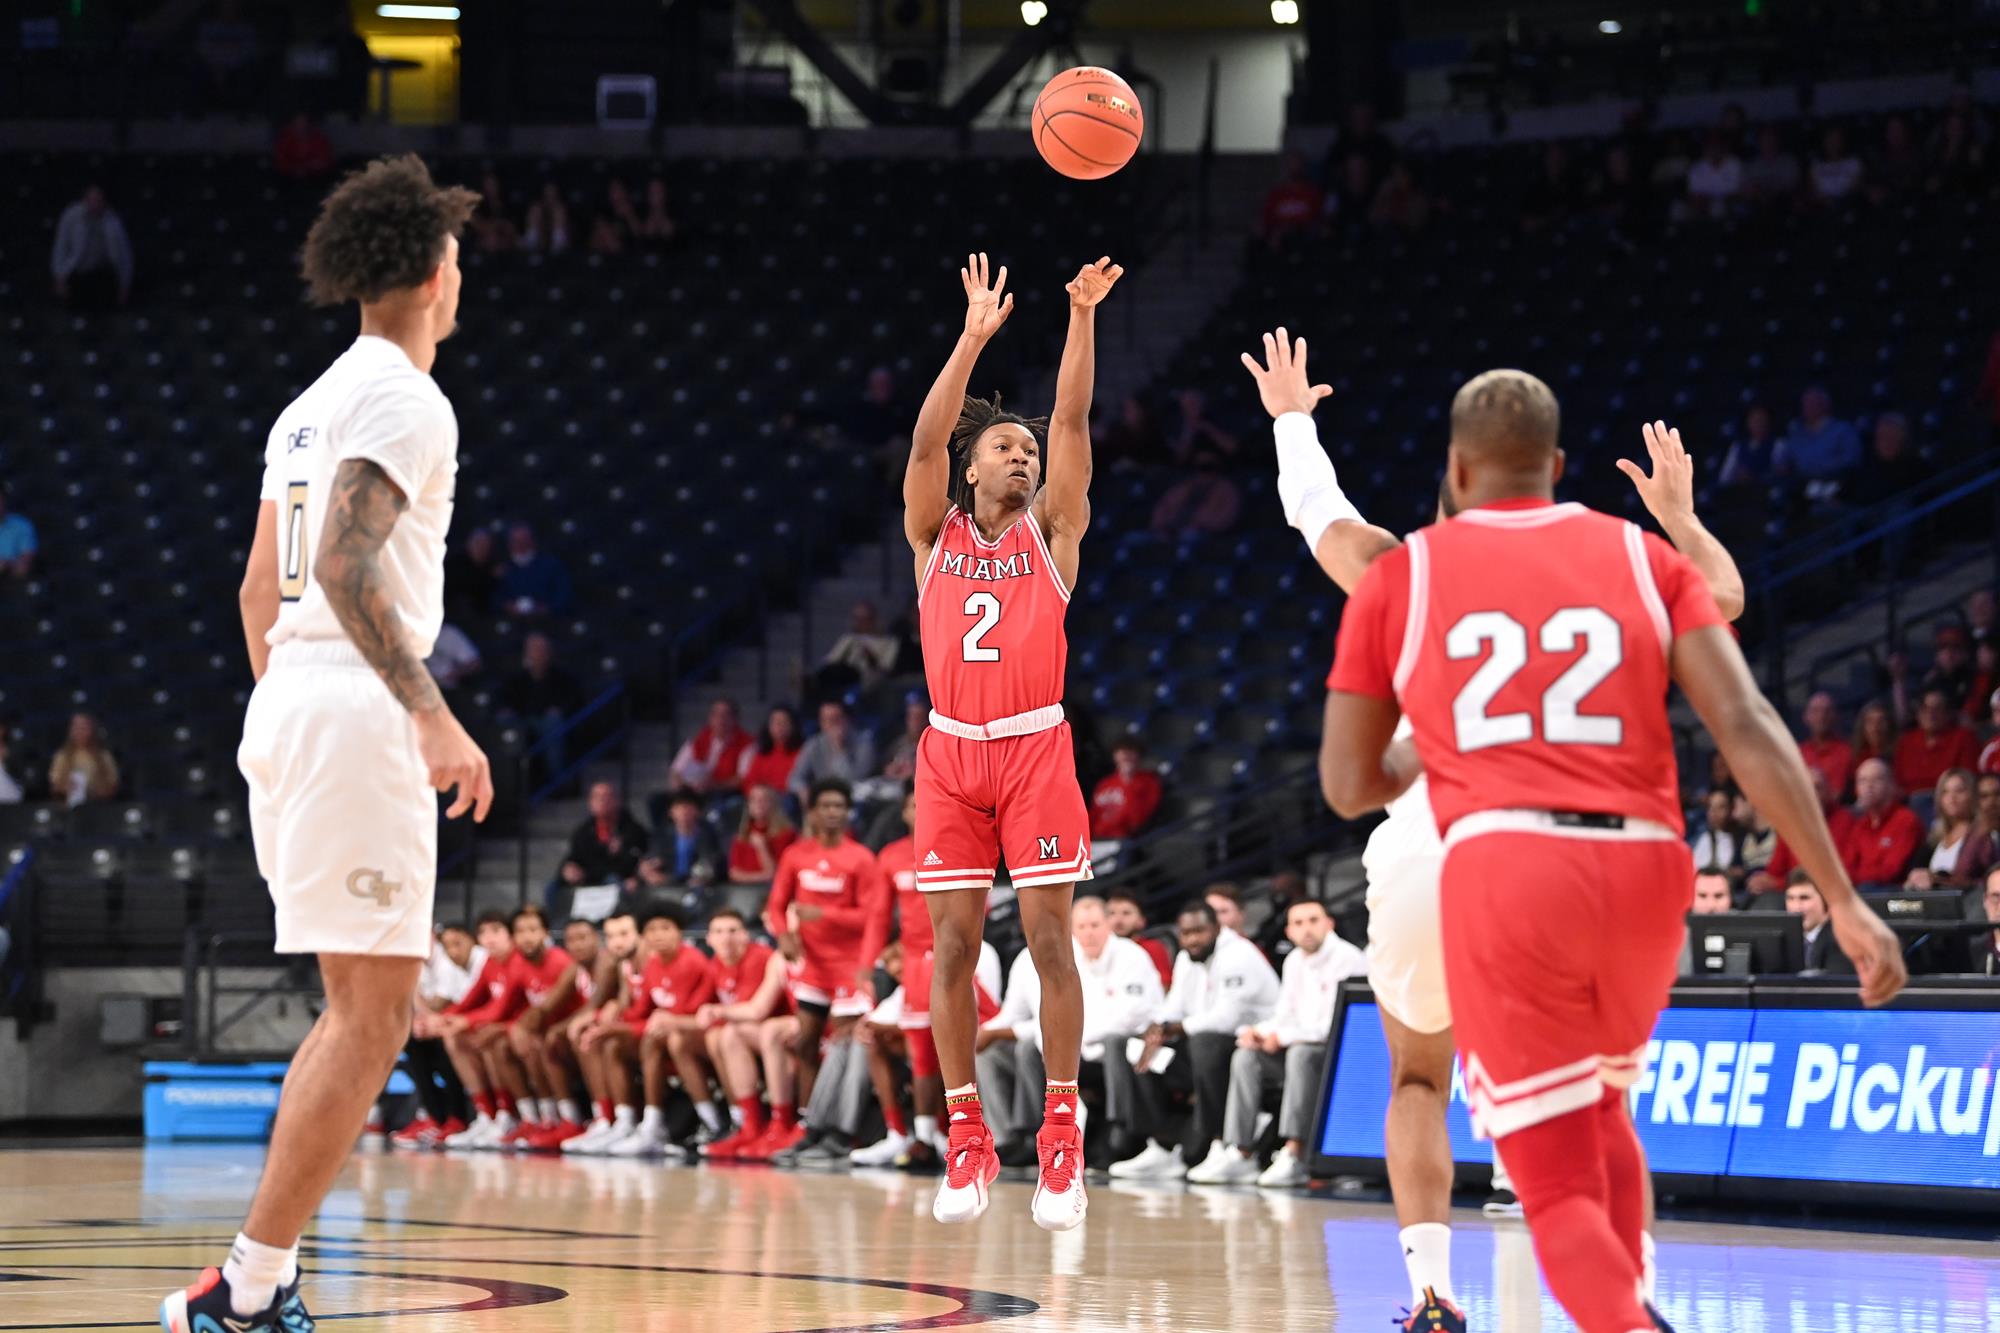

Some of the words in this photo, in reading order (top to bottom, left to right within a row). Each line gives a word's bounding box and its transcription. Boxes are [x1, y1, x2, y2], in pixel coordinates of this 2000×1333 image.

[288, 427, 317, 453] DE
[281, 481, 308, 602] 0
[939, 550, 1034, 581] MIAMI
[962, 592, 1001, 662] 2
[1445, 606, 1624, 754] 22
[1037, 835, 1060, 860] M
[346, 867, 402, 907] GT
[1629, 1040, 1775, 1127] FREE
